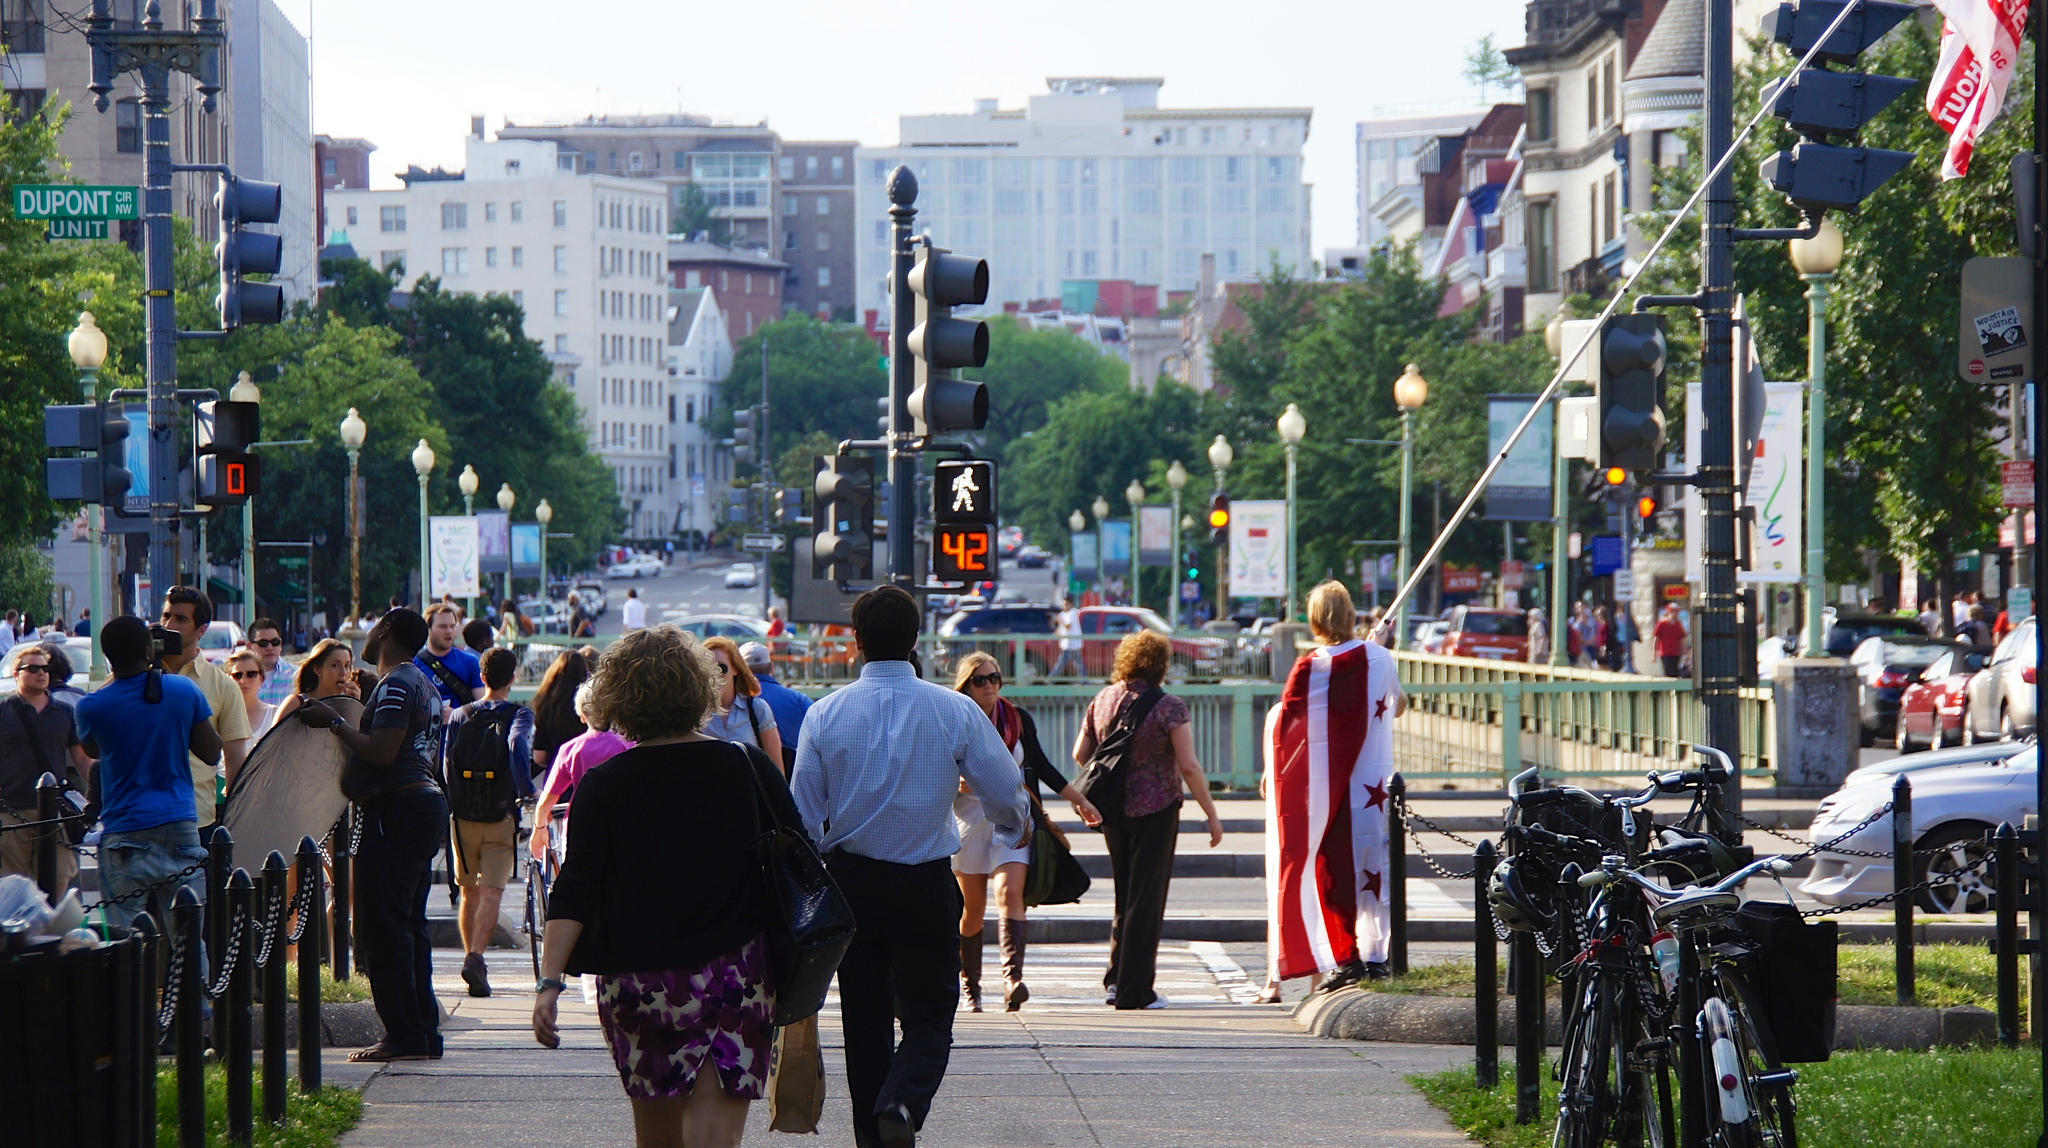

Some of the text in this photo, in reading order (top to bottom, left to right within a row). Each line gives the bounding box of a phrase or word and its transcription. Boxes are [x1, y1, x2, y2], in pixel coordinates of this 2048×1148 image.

[1990, 50, 2007, 69] DC
[20, 190, 112, 215] DUPONT
[115, 191, 132, 202] CIR
[115, 204, 132, 214] NW
[50, 220, 105, 237] UNIT
[1976, 308, 2015, 327] MOUNTAIN
[1987, 317, 2018, 332] JUSTICE
[2007, 475, 2032, 483] ROUTE
[942, 532, 988, 570] 42
[1449, 577, 1478, 588] ATM
